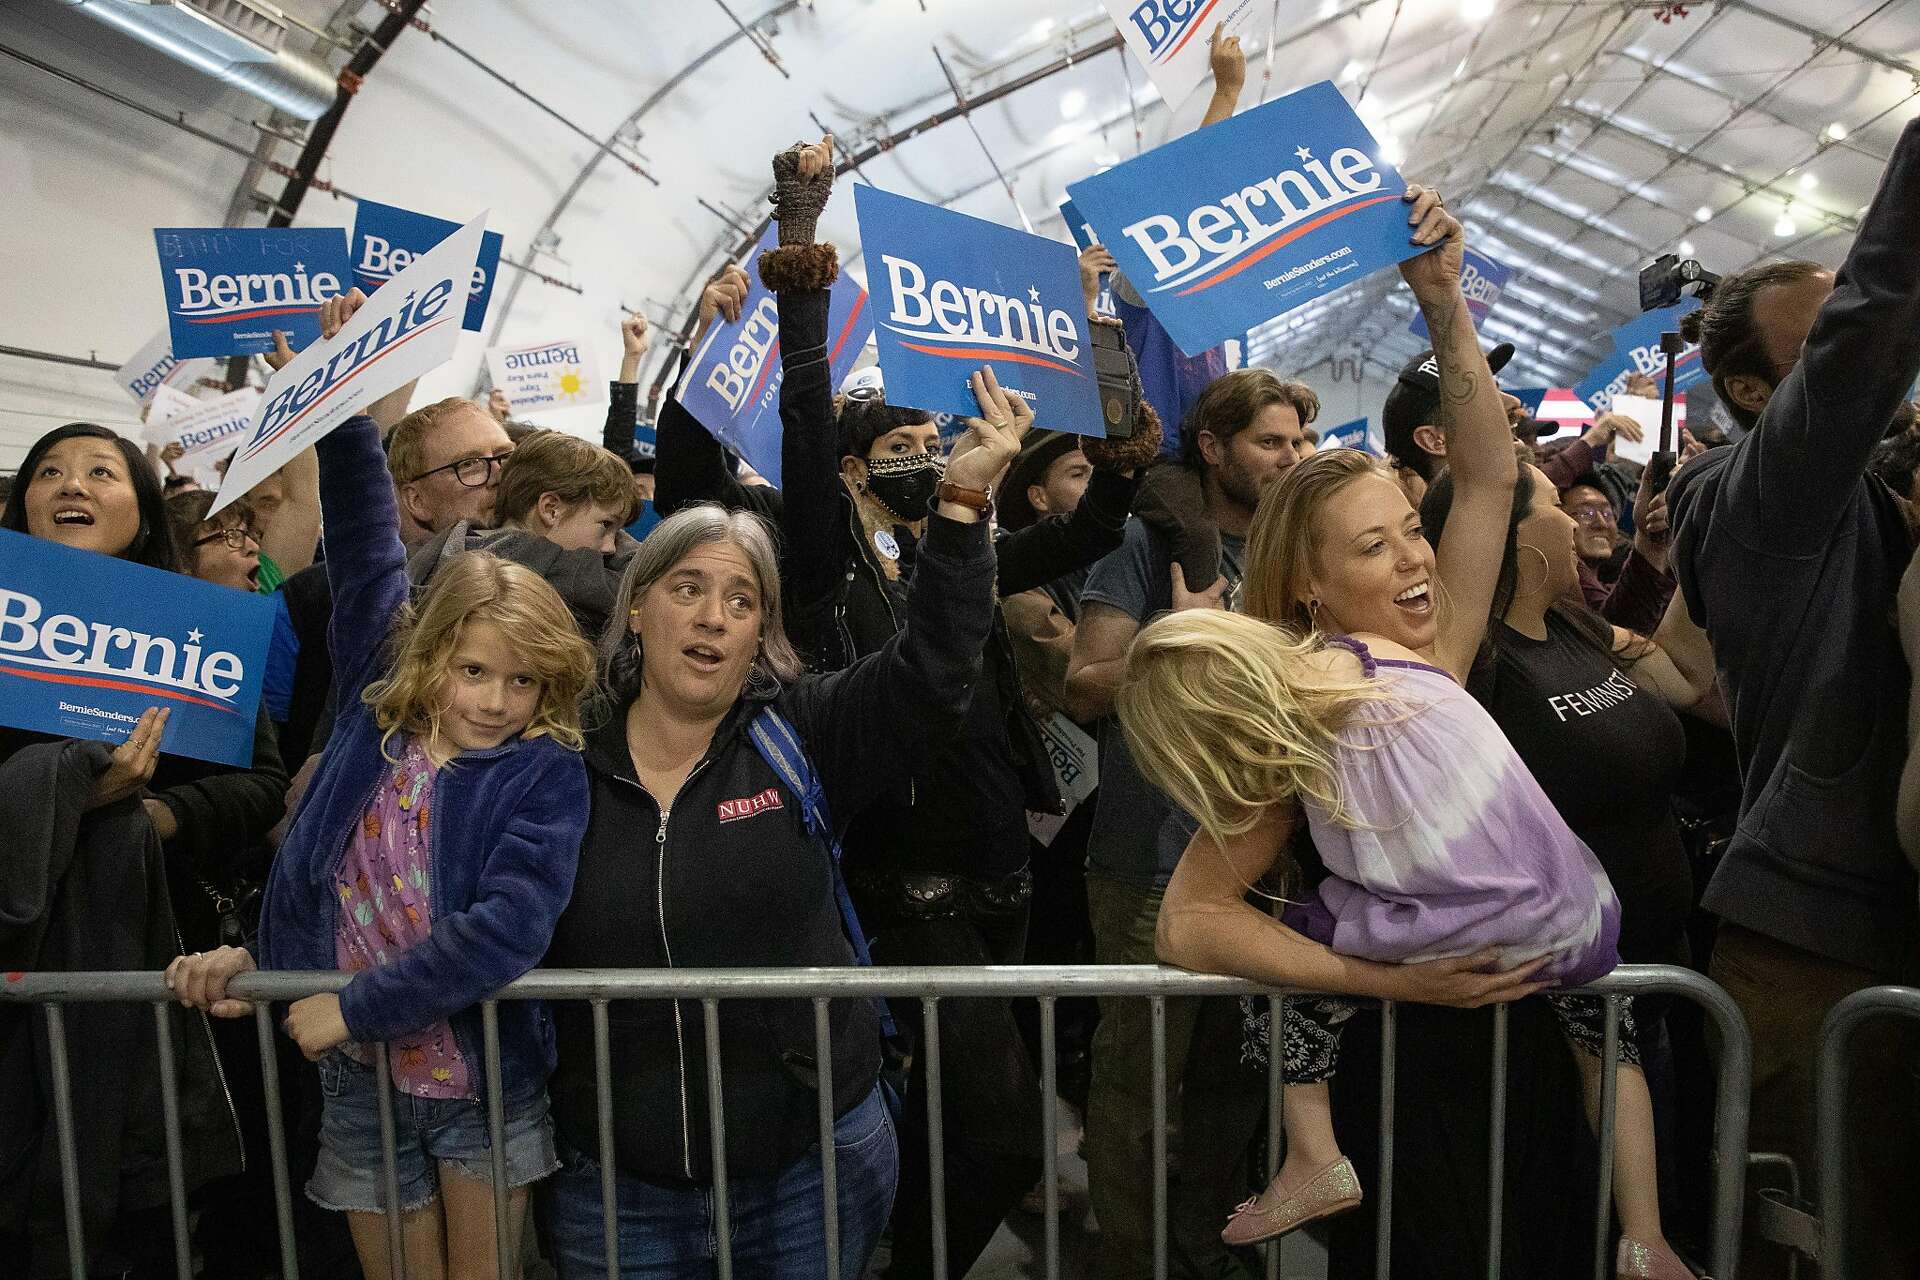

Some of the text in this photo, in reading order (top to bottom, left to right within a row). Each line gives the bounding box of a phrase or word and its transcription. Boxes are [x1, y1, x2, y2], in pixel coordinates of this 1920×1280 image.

[1122, 143, 1382, 282] Bernie
[175, 261, 341, 309] Bernie
[1263, 246, 1353, 290] BernieSanders.com
[1460, 263, 1501, 305] Bern
[881, 254, 1079, 361] Bernie
[128, 353, 178, 399] Bern
[248, 279, 453, 448] Bernie
[505, 347, 581, 370] Bernie
[706, 296, 780, 411] Bern
[760, 384, 778, 409] FOR
[180, 416, 250, 450] Bernie
[0, 587, 244, 699] Bernie
[58, 701, 141, 724] BernieSanders.c
[1547, 667, 1638, 722] FEMINIST
[719, 790, 780, 818] NUHW
